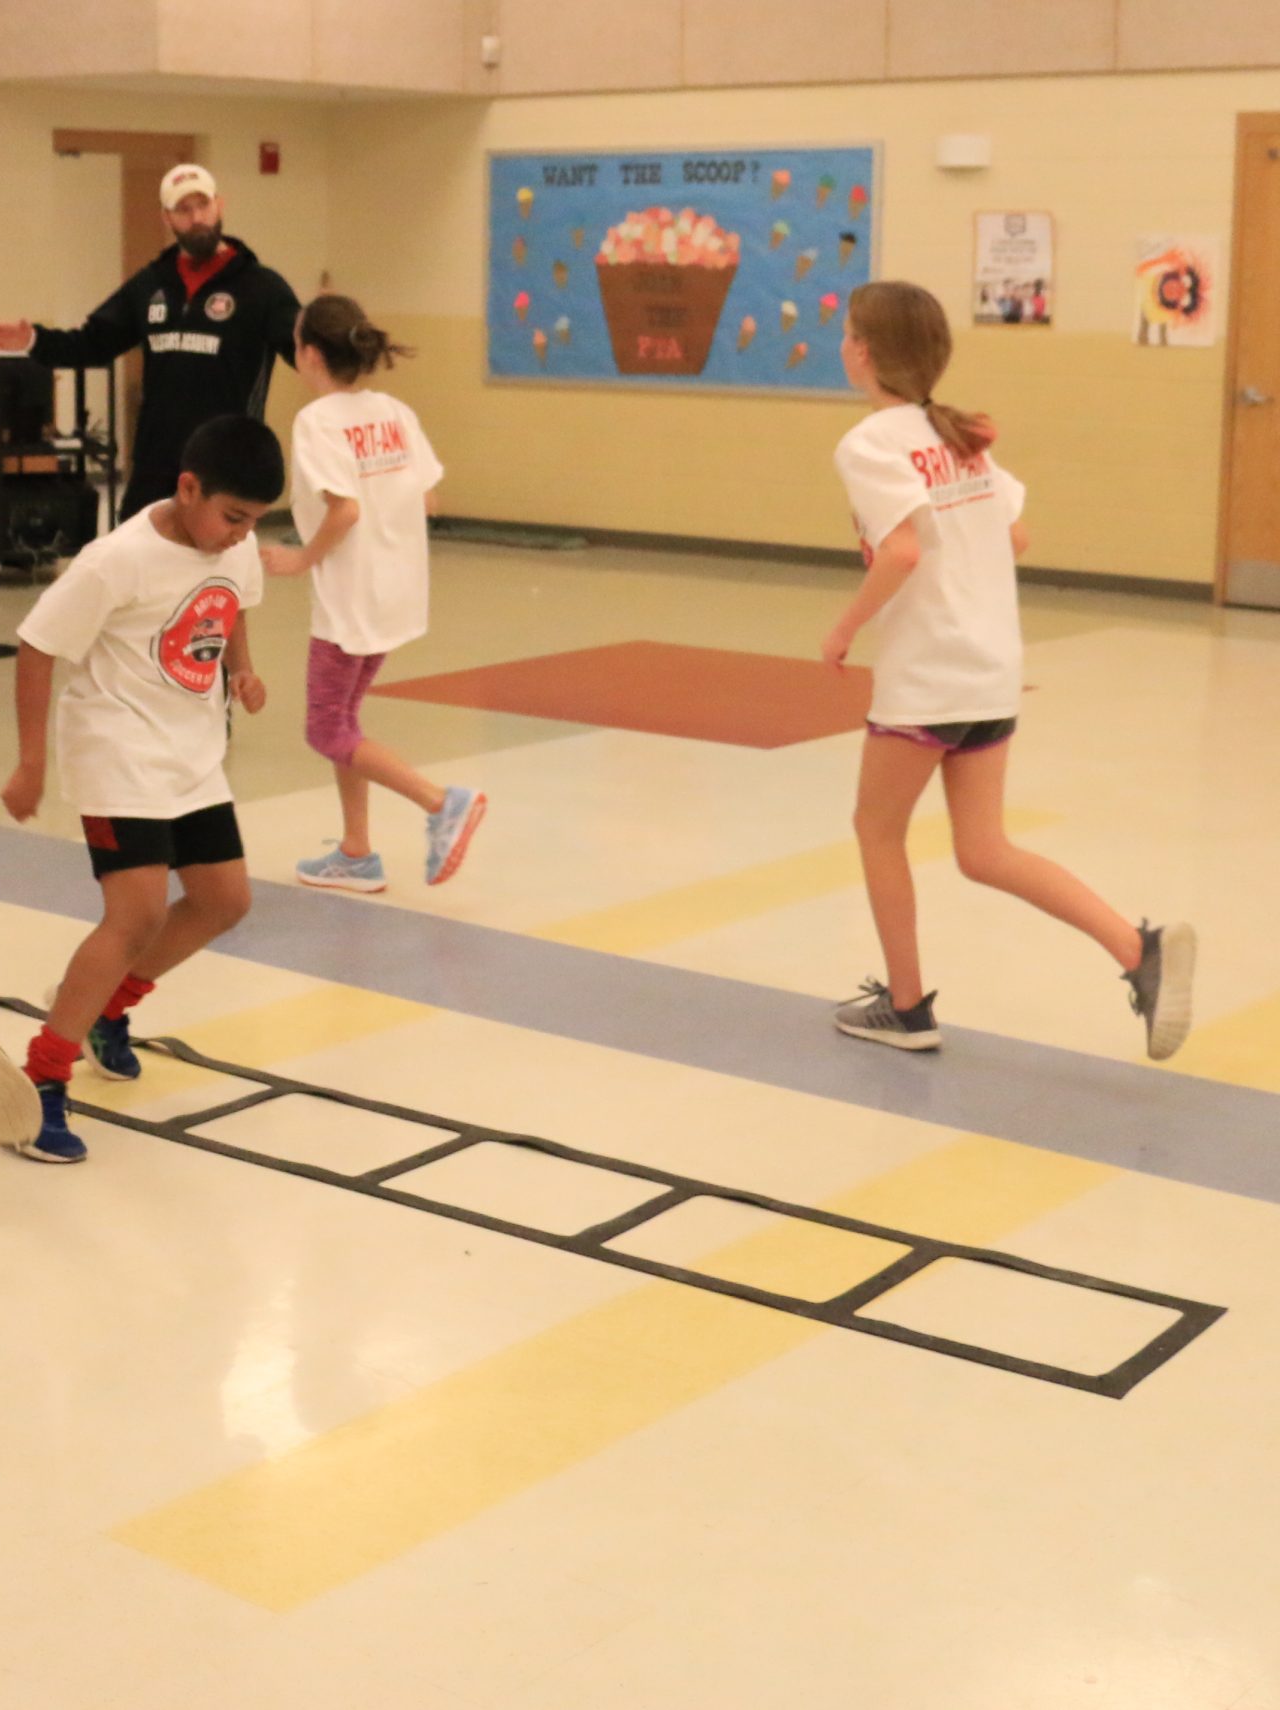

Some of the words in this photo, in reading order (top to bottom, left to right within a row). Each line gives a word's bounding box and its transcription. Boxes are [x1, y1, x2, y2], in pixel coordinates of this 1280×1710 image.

[543, 164, 598, 187] WANT
[621, 162, 662, 185] THE
[682, 160, 761, 184] SCOOP?
[637, 335, 684, 359] PTA
